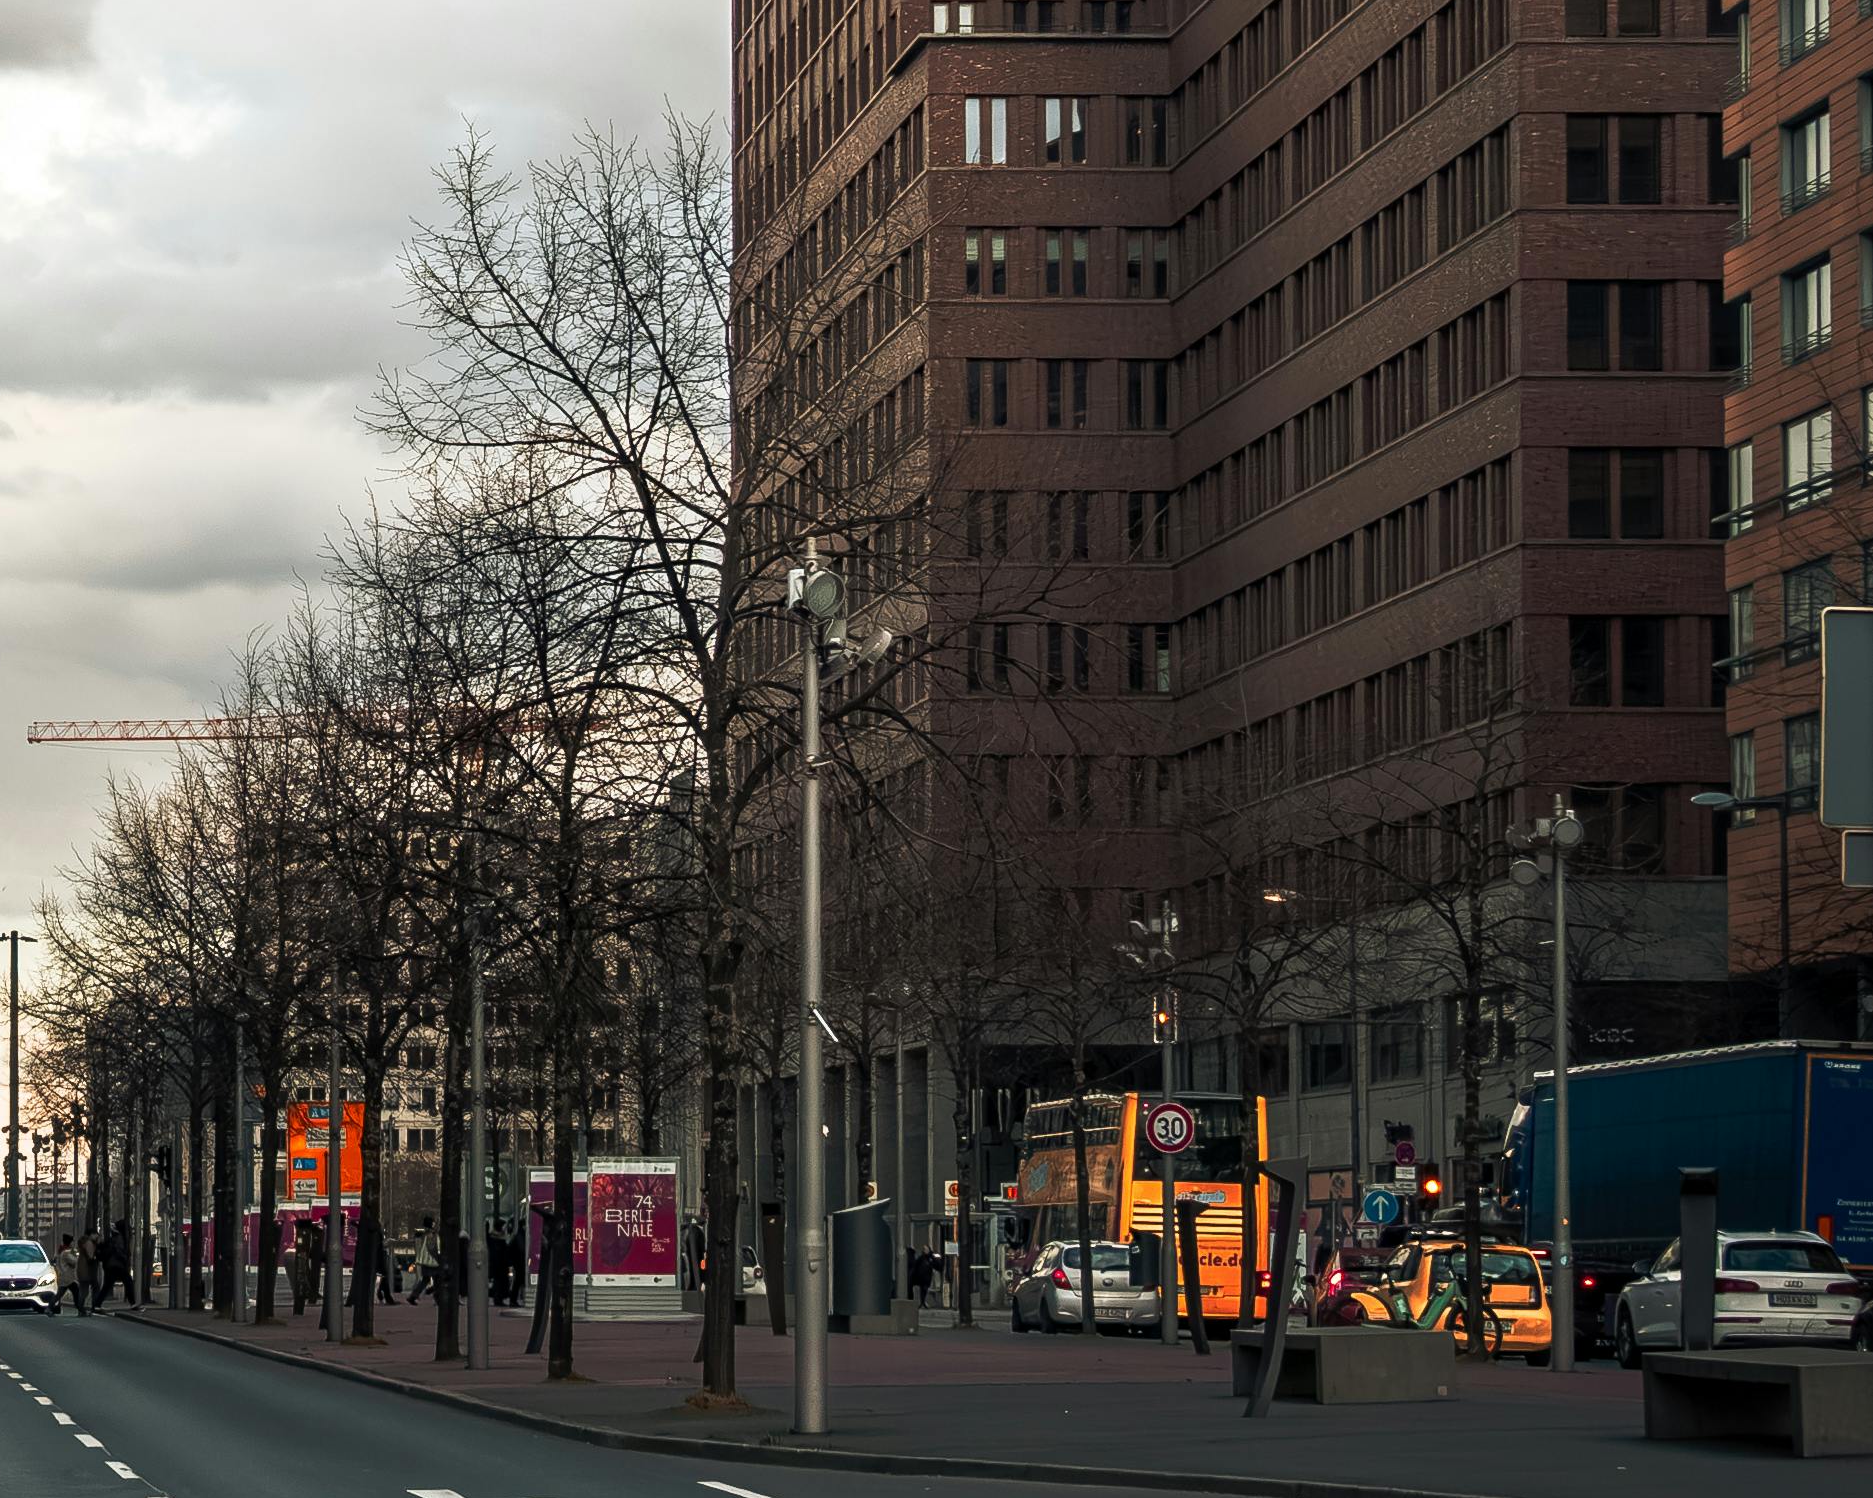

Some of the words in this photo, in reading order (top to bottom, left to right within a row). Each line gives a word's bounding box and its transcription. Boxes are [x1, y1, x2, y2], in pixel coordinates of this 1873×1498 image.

[1157, 1117, 1184, 1139] 30
[634, 1195, 656, 1208] 74.
[605, 1209, 653, 1223] BERLI
[617, 1224, 653, 1237] NALE
